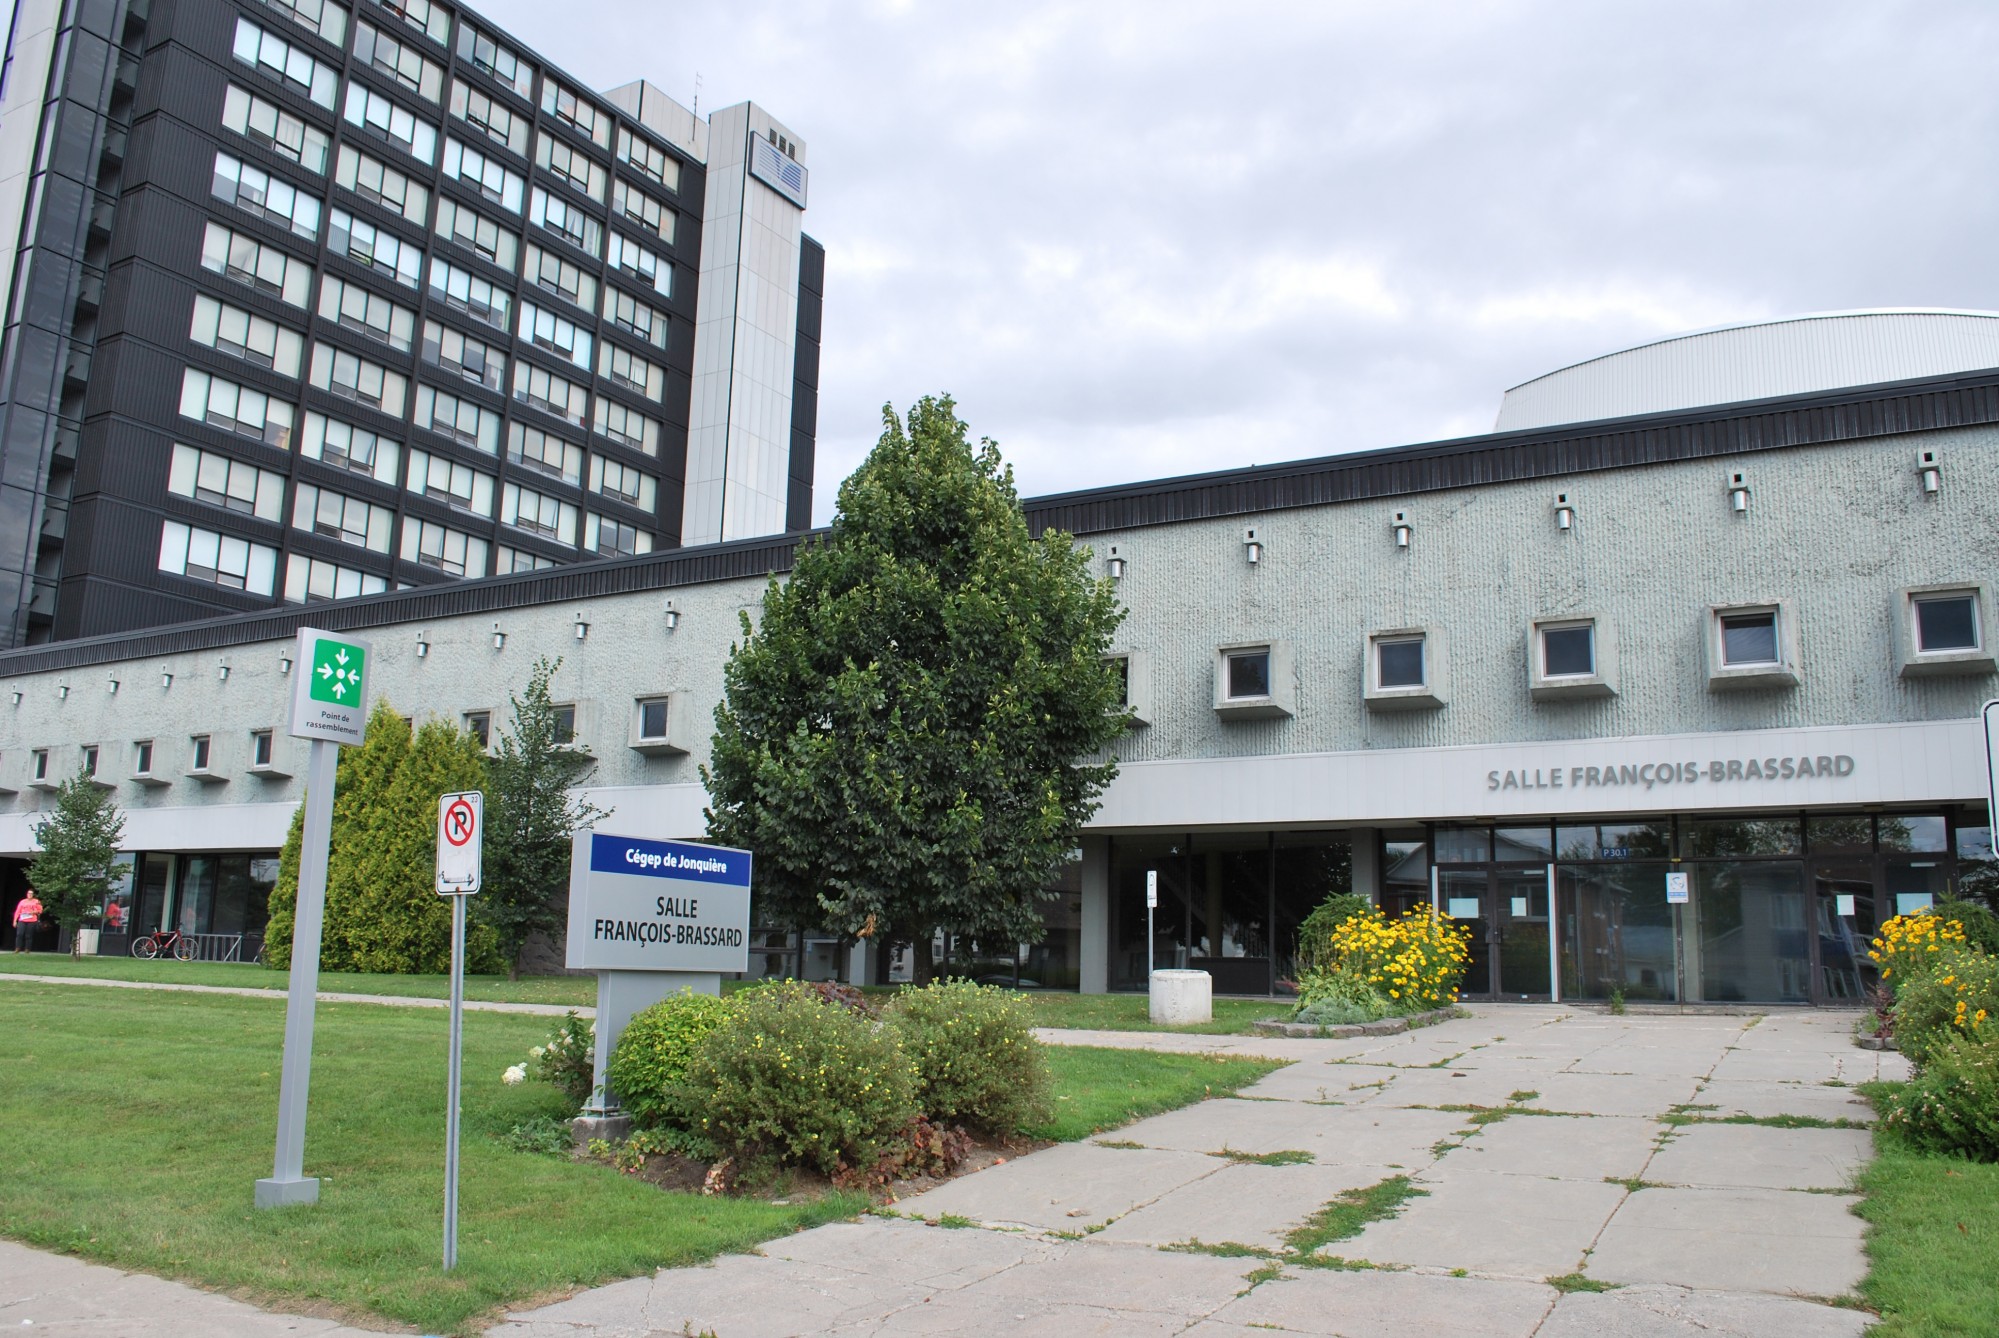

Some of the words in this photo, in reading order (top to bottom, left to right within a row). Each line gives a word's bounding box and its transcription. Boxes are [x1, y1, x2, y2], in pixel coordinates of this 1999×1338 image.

[306, 720, 359, 736] rassemblement
[321, 710, 341, 721] Point
[341, 714, 350, 723] de
[1487, 768, 1563, 791] SALLE
[1571, 754, 1855, 790] FRANÇOIS-BRASSARD
[625, 848, 662, 869] Cégep
[663, 852, 677, 868] de
[678, 854, 727, 874] Jonquière
[1603, 849, 1611, 857] P
[1611, 848, 1627, 857] 30.1
[656, 896, 698, 919] SALLE
[594, 918, 743, 948] FRANÇOIS-BRASSARD
